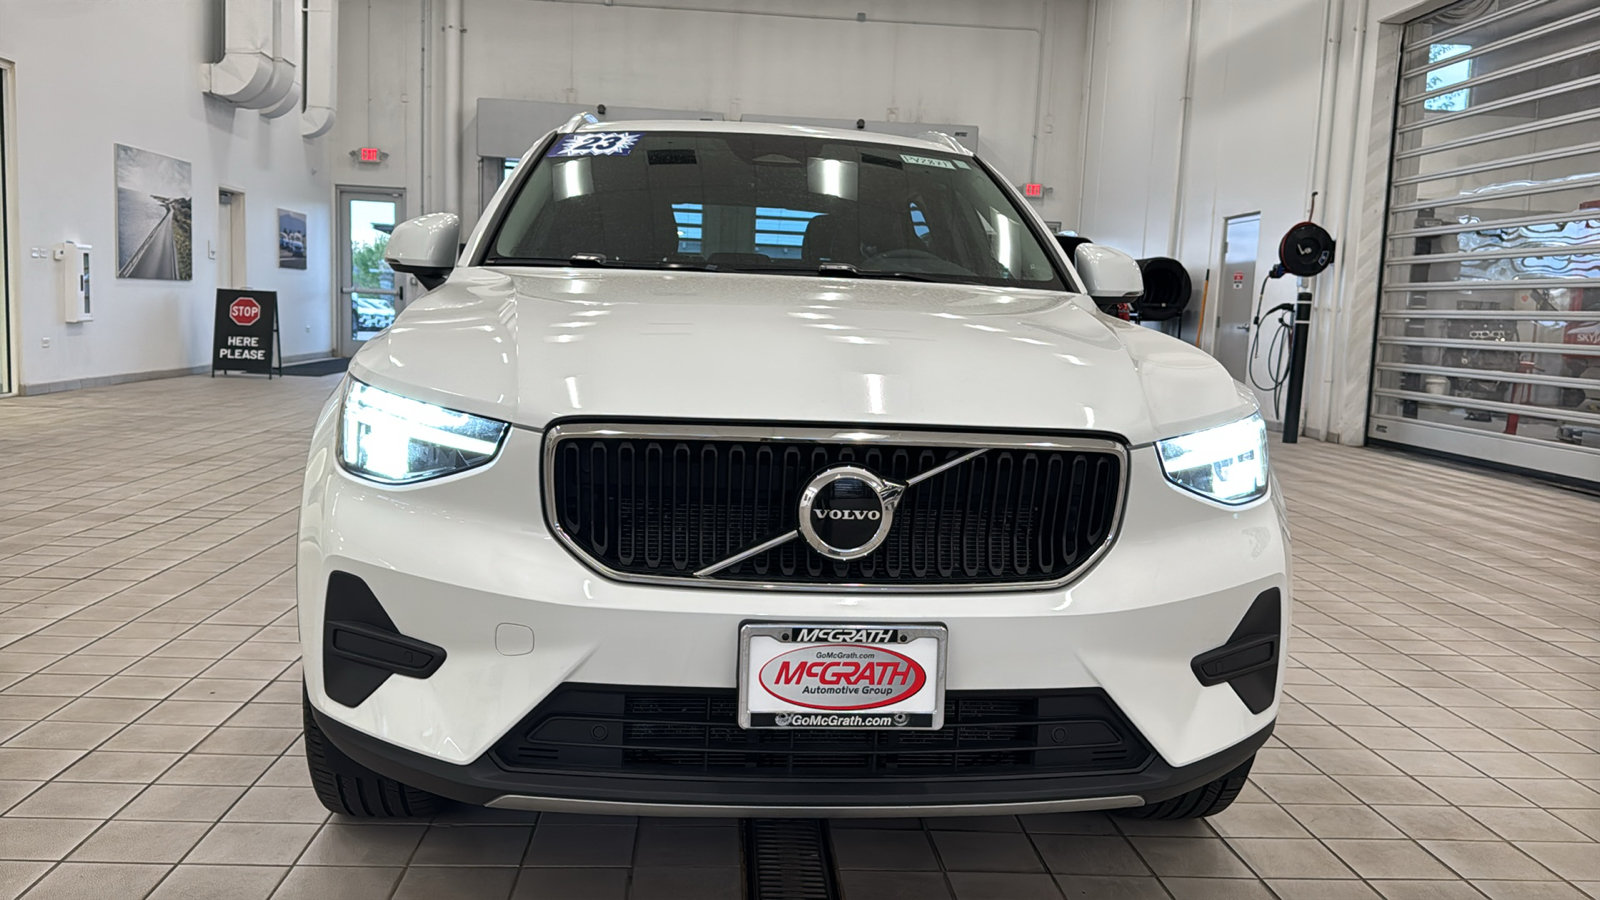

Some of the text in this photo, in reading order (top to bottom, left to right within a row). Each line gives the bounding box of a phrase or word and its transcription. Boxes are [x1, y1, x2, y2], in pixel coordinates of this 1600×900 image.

[572, 136, 622, 150] 23
[361, 148, 377, 160] EXIT
[1026, 183, 1041, 196] EXIT
[232, 306, 258, 317] STOP
[228, 336, 258, 347] HERE
[220, 348, 265, 360] PLEASE
[813, 509, 881, 520] VOLVO
[815, 651, 876, 660] GoMcGrath.com
[802, 685, 893, 697] Automotive Group
[791, 713, 892, 727] GoMcGrath.com
